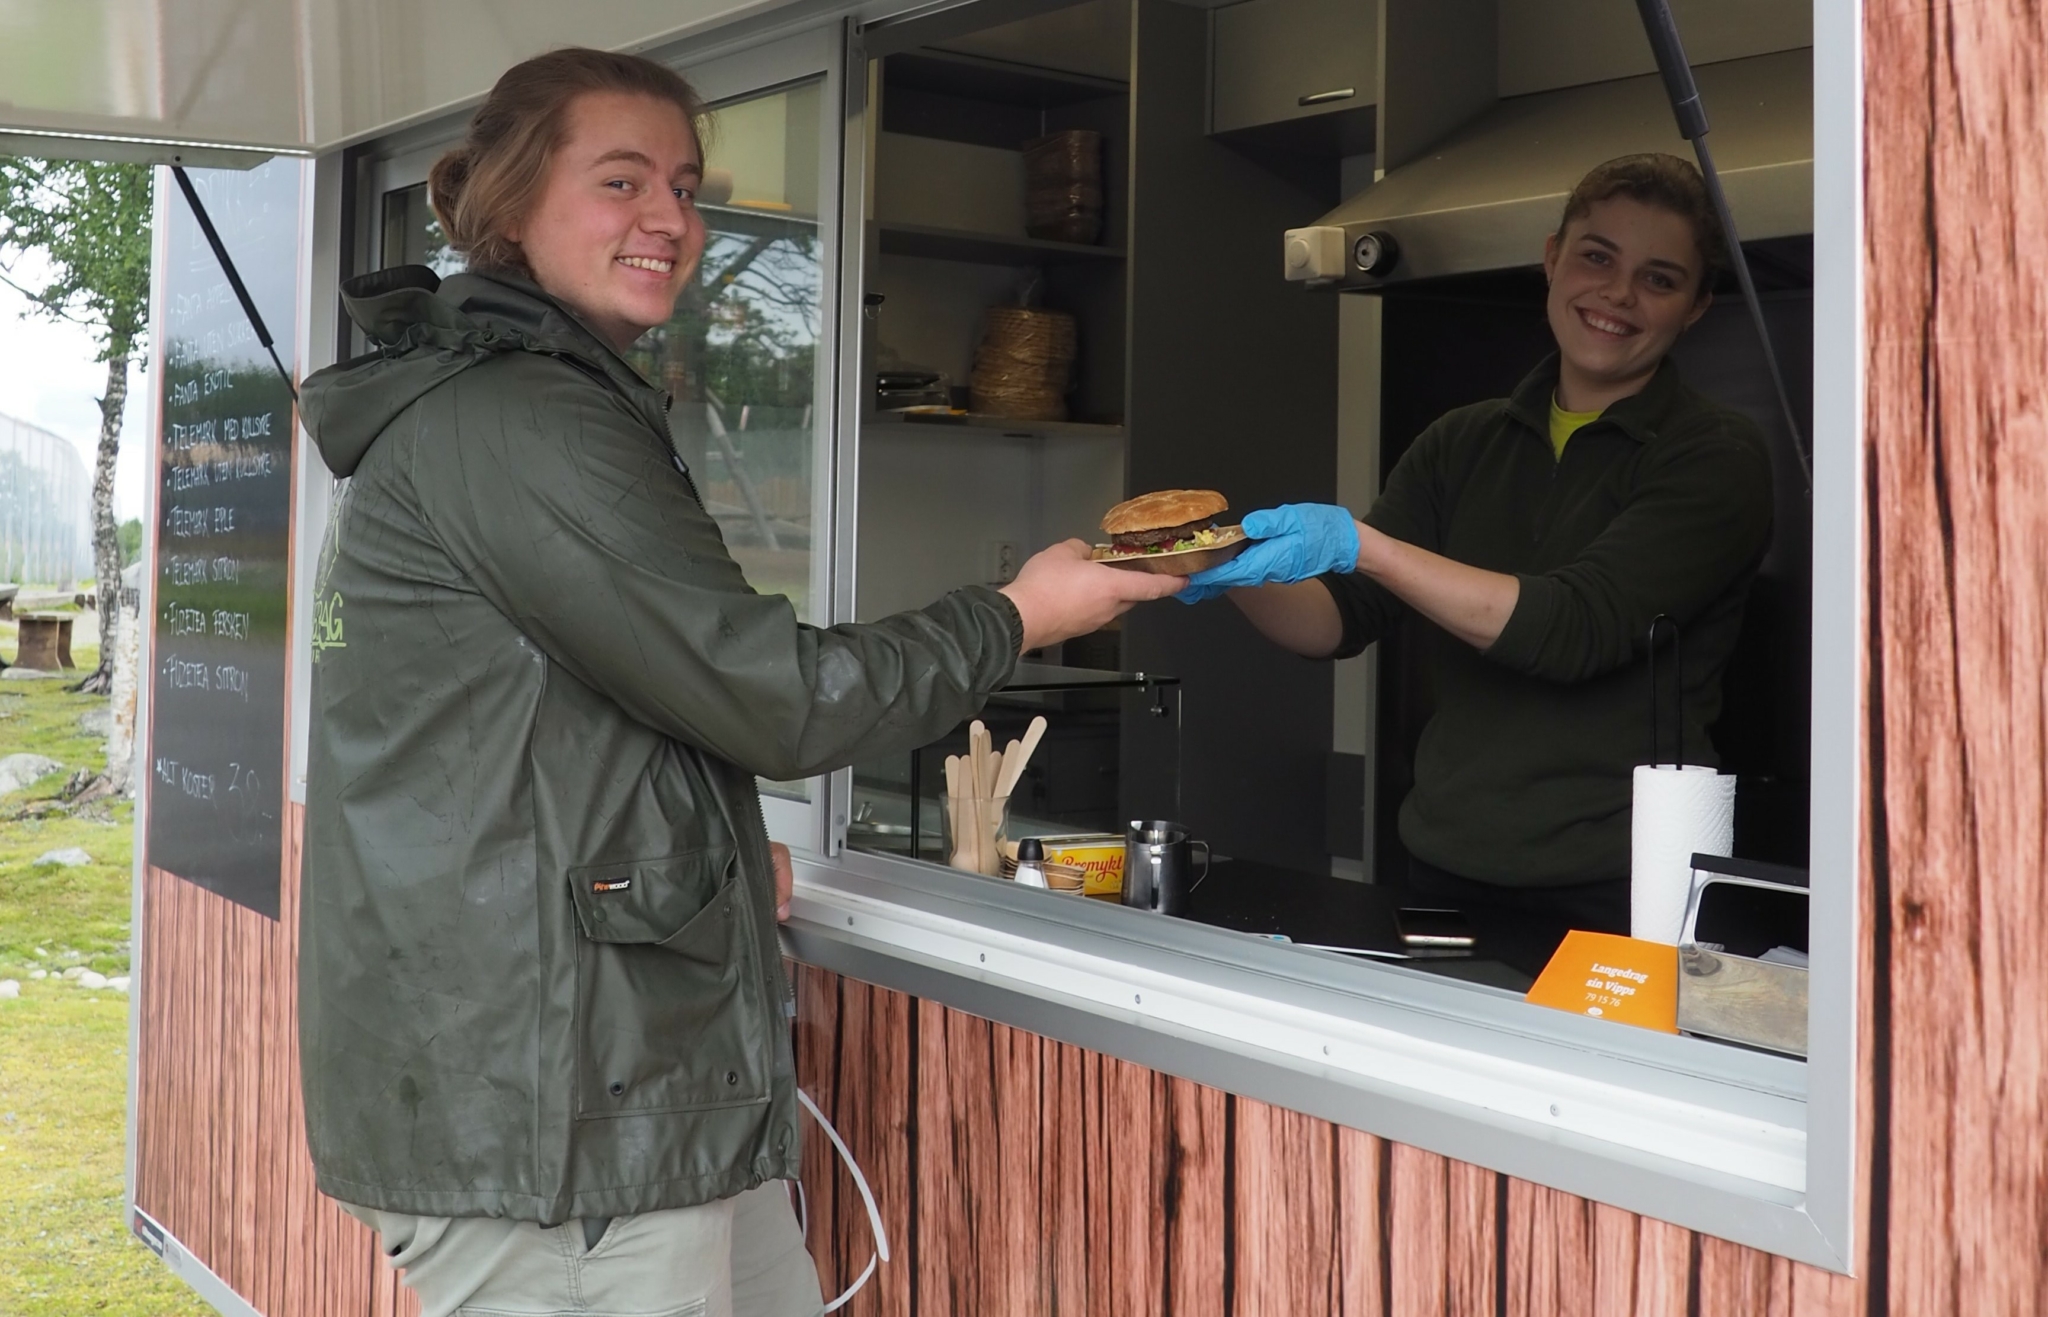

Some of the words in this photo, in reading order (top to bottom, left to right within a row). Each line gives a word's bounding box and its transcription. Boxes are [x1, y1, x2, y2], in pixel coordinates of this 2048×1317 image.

[174, 379, 198, 407] FANTA
[204, 369, 234, 395] EXOTIC
[172, 419, 218, 451] TELEMARK
[224, 417, 239, 441] MED
[172, 462, 209, 491] TELEMARK
[214, 459, 233, 483] UTEN
[171, 505, 209, 538] TELEMARK
[214, 507, 235, 533] EPLE
[170, 555, 208, 586] TELEMARK
[212, 556, 239, 585] SITRON
[212, 608, 249, 641] FERSKEN
[215, 665, 249, 702] SITRON
[182, 767, 217, 808] KOSTER
[1062, 855, 1122, 883] Bremykt
[1585, 978, 1603, 989] sin
[1605, 980, 1636, 997] Vipps
[1590, 963, 1649, 984] Langedrag
[1585, 992, 1597, 1001] 79
[1598, 994, 1608, 1005] 15
[1609, 997, 1621, 1007] 76
